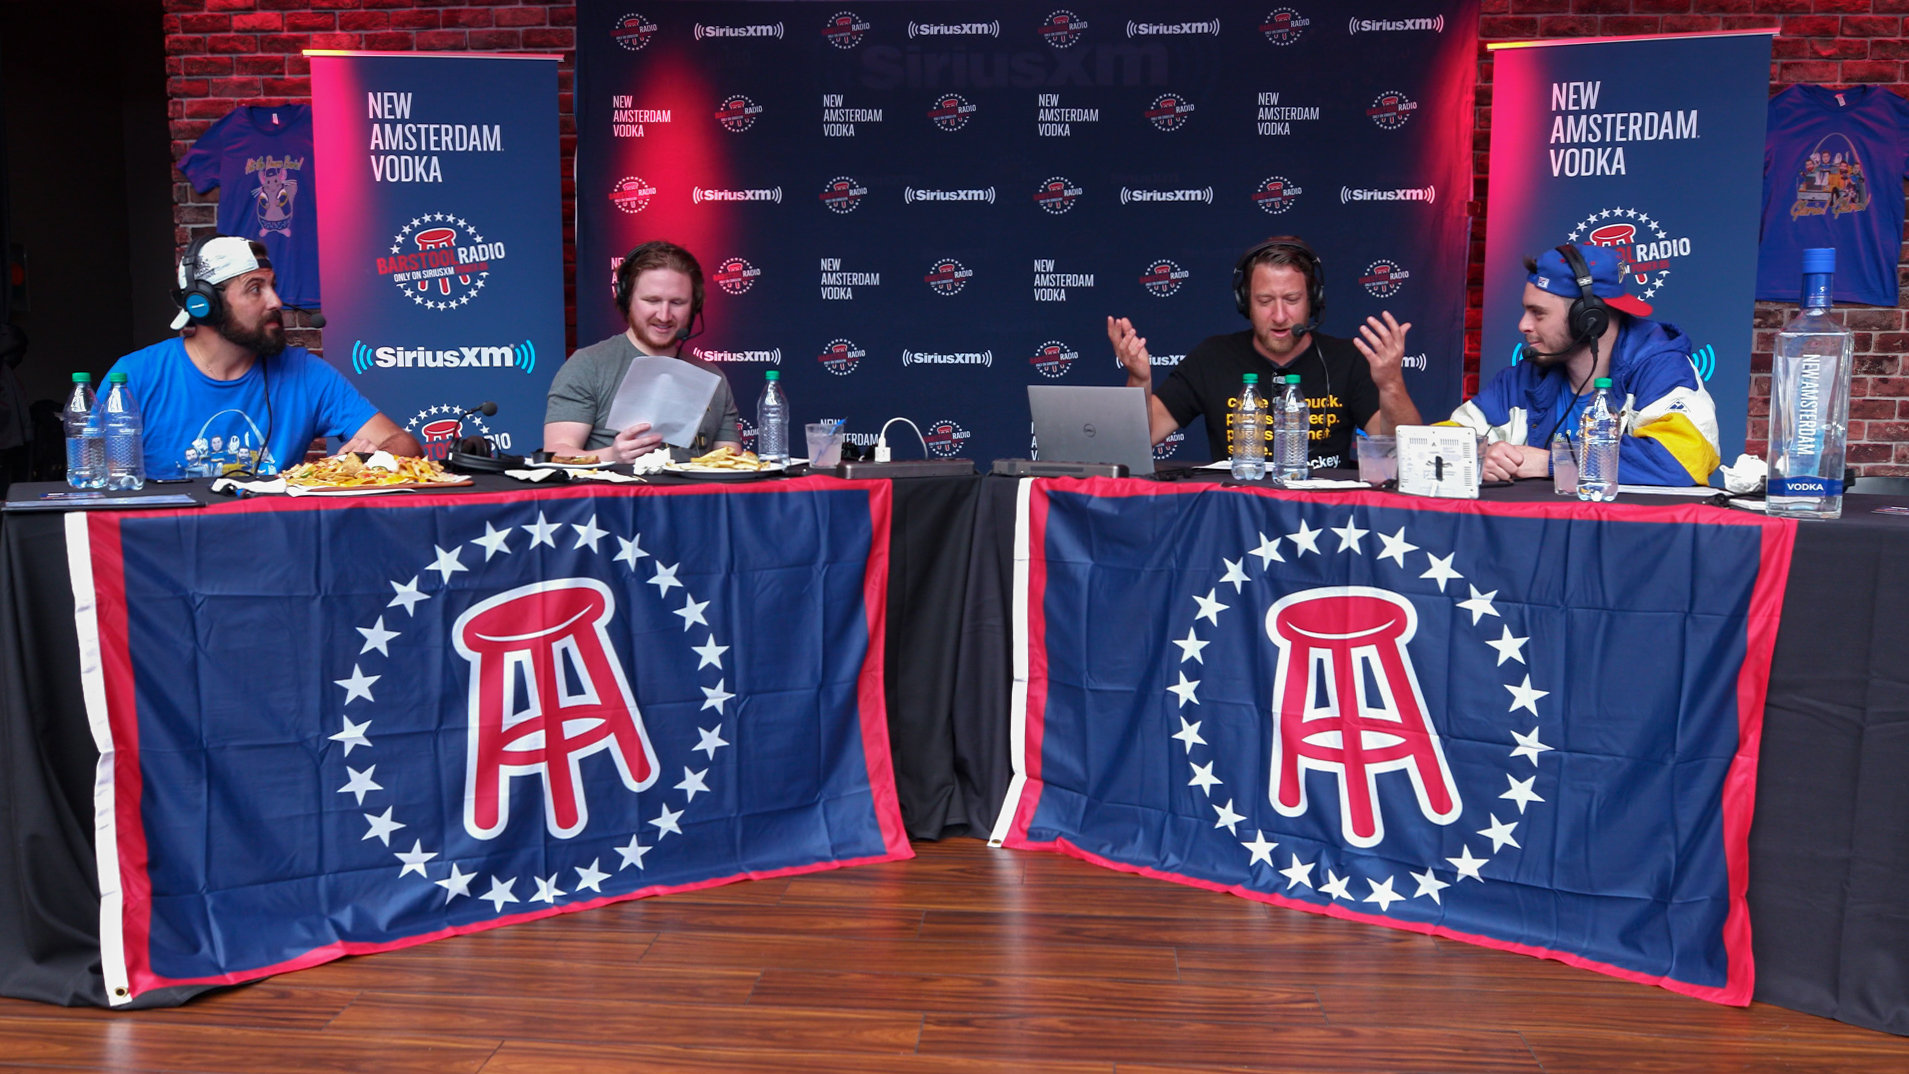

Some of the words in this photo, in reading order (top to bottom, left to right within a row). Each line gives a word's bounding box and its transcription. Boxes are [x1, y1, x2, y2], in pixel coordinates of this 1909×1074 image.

[613, 96, 632, 108] NEW
[823, 94, 843, 107] NEW
[1038, 94, 1059, 106] NEW
[1258, 92, 1279, 105] NEW
[1551, 81, 1601, 112] NEW
[368, 92, 412, 119] NEW
[613, 110, 671, 122] AMSTERDAM
[823, 109, 882, 122] AMSTERDAM
[1038, 109, 1099, 122] AMSTERDAM
[1258, 107, 1319, 120] AMSTERDAM
[613, 124, 644, 137] VODKA
[823, 124, 855, 136] VODKA
[1038, 123, 1070, 136] VODKA
[1258, 122, 1290, 135] VODKA
[1550, 147, 1626, 177] VODKA
[370, 155, 443, 183] VODKA
[1636, 237, 1691, 262] RADIO
[376, 249, 459, 275] BARSTOOL
[457, 241, 506, 265] RADIO
[821, 258, 841, 271] NEW
[1034, 259, 1055, 272] NEW
[393, 272, 411, 283] ONLY
[411, 271, 422, 280] ON
[422, 266, 455, 279] SIRIUSXM
[821, 273, 880, 286] AMSTERDAM
[1034, 274, 1094, 287] AMSTERDAM
[821, 287, 852, 300] VODKA
[1034, 288, 1066, 301] VODKA
[1802, 354, 1821, 381] NEW
[1308, 414, 1340, 427] eep.
[1797, 381, 1820, 455] AMSTERDAM
[1787, 483, 1824, 491] VODKA
